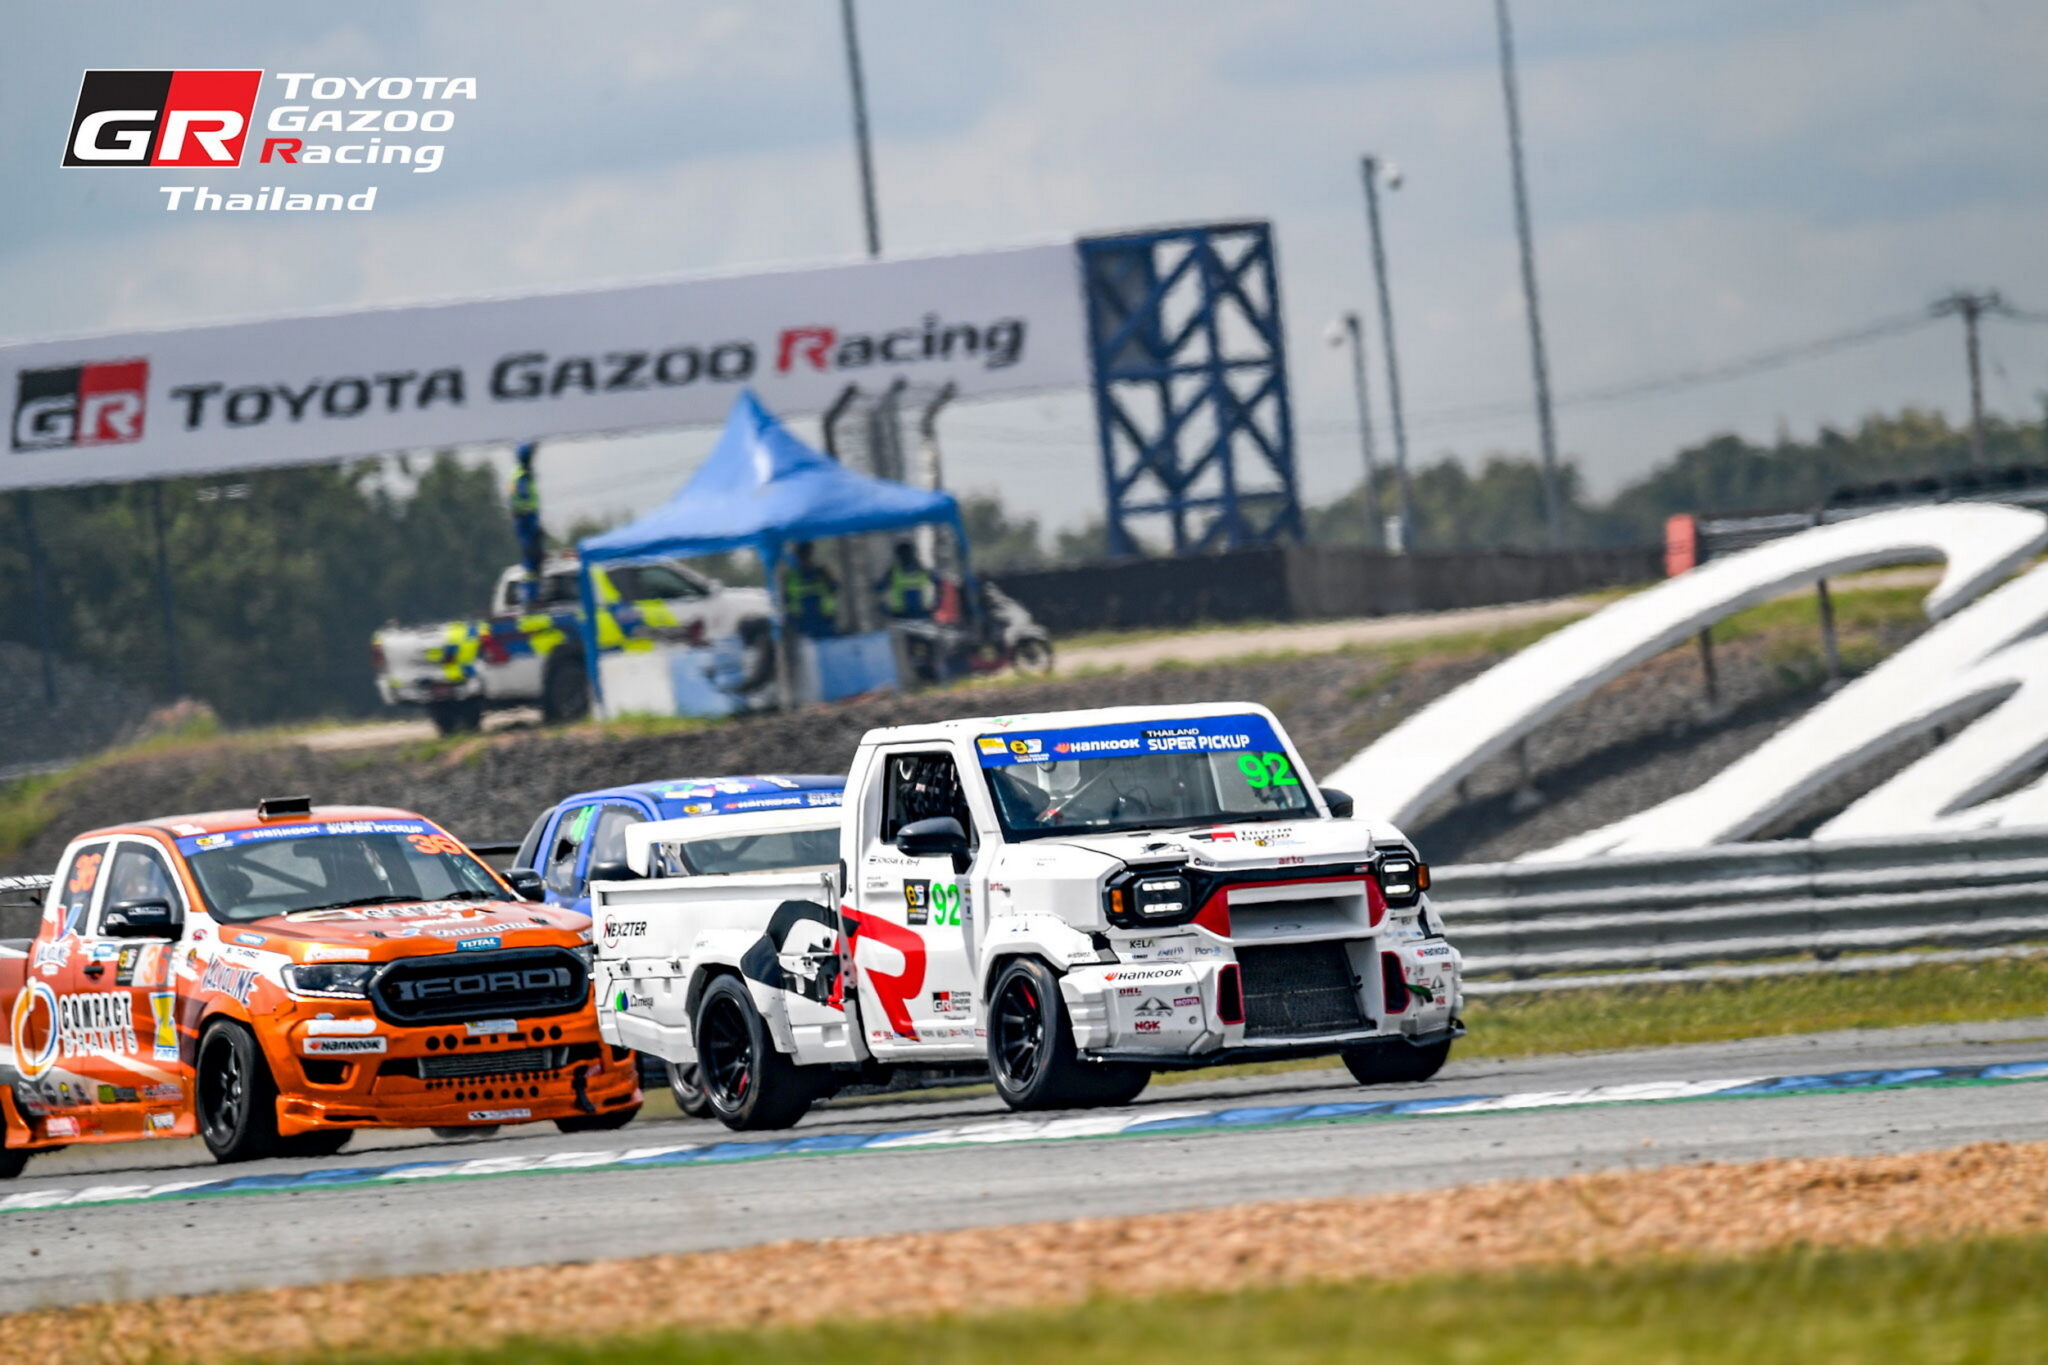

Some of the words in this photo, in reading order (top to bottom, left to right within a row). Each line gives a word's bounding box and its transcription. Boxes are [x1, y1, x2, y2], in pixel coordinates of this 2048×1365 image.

[170, 367, 466, 431] TOYOTA
[489, 341, 756, 400] GAZOO
[777, 313, 1027, 372] Racing
[1146, 728, 1200, 737] THAILAND
[1148, 736, 1196, 751] SUPER
[1198, 734, 1250, 749] PICKUP
[1237, 752, 1298, 789] 92
[407, 834, 463, 856] 36
[1278, 856, 1304, 866] arto
[931, 883, 961, 926] 92
[603, 919, 648, 939] NEXZTER
[461, 938, 497, 949] TOTAL
[413, 970, 554, 1000] FORD
[61, 997, 131, 1030] COMPACT
[1135, 1021, 1160, 1030] NGK
